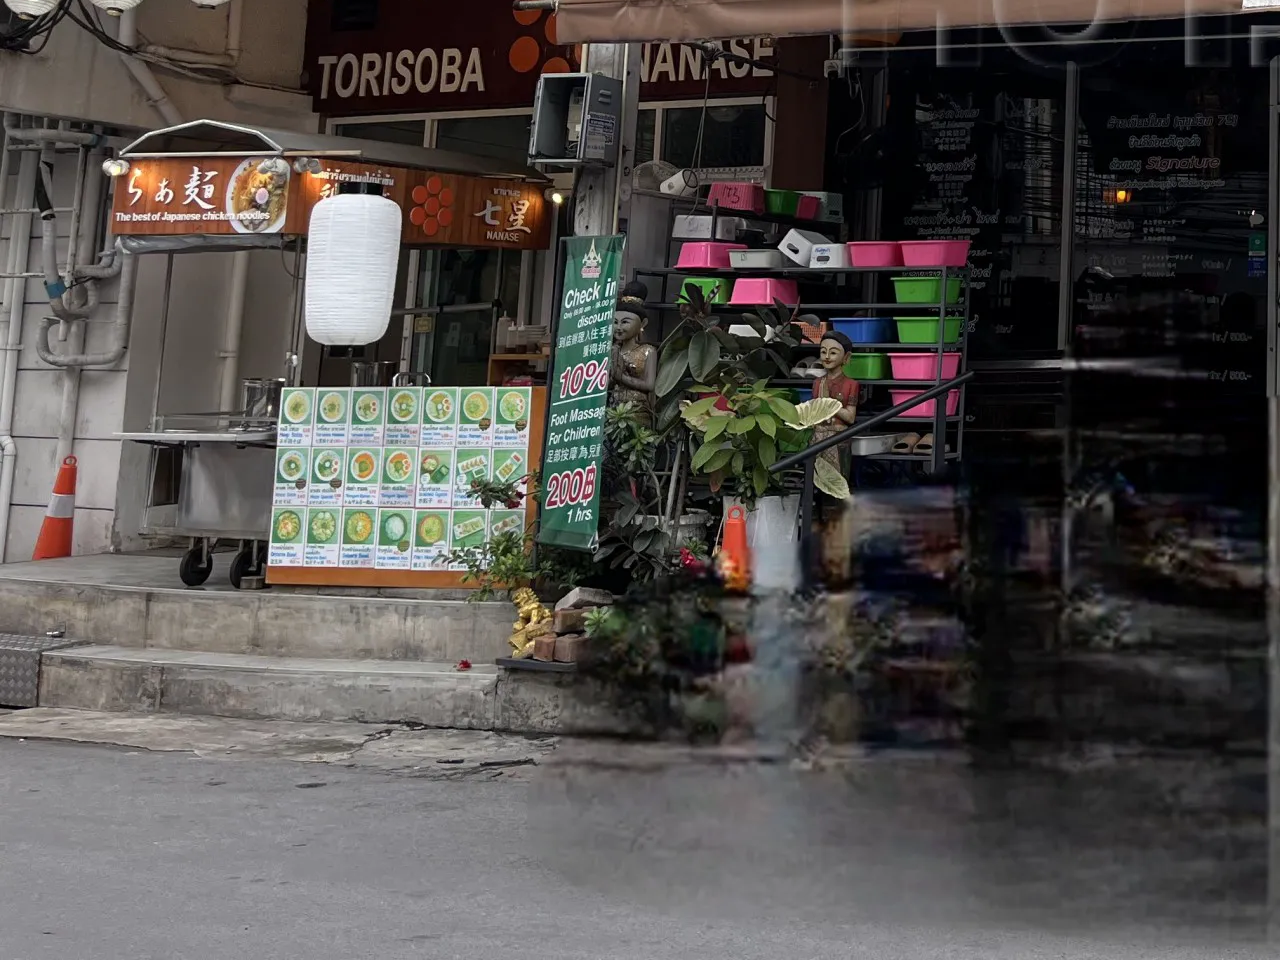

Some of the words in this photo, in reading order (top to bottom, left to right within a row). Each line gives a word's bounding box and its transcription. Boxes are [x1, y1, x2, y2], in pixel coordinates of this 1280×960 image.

[318, 46, 485, 100] TORISOBA
[1145, 155, 1221, 173] Signature
[116, 212, 132, 221] The
[132, 212, 151, 221] best
[151, 211, 161, 221] of
[161, 211, 201, 223] Japanese
[202, 210, 236, 221] chicken
[236, 210, 270, 220] noodles
[474, 199, 532, 234] 七星
[486, 230, 519, 242] NANASE
[564, 281, 601, 309] Check
[577, 308, 613, 329] discount
[559, 357, 609, 399] 10%
[550, 409, 568, 427] Foot
[548, 432, 562, 446] For
[563, 425, 601, 443] Children
[566, 509, 573, 524] 1
[575, 506, 593, 522] hrs.
